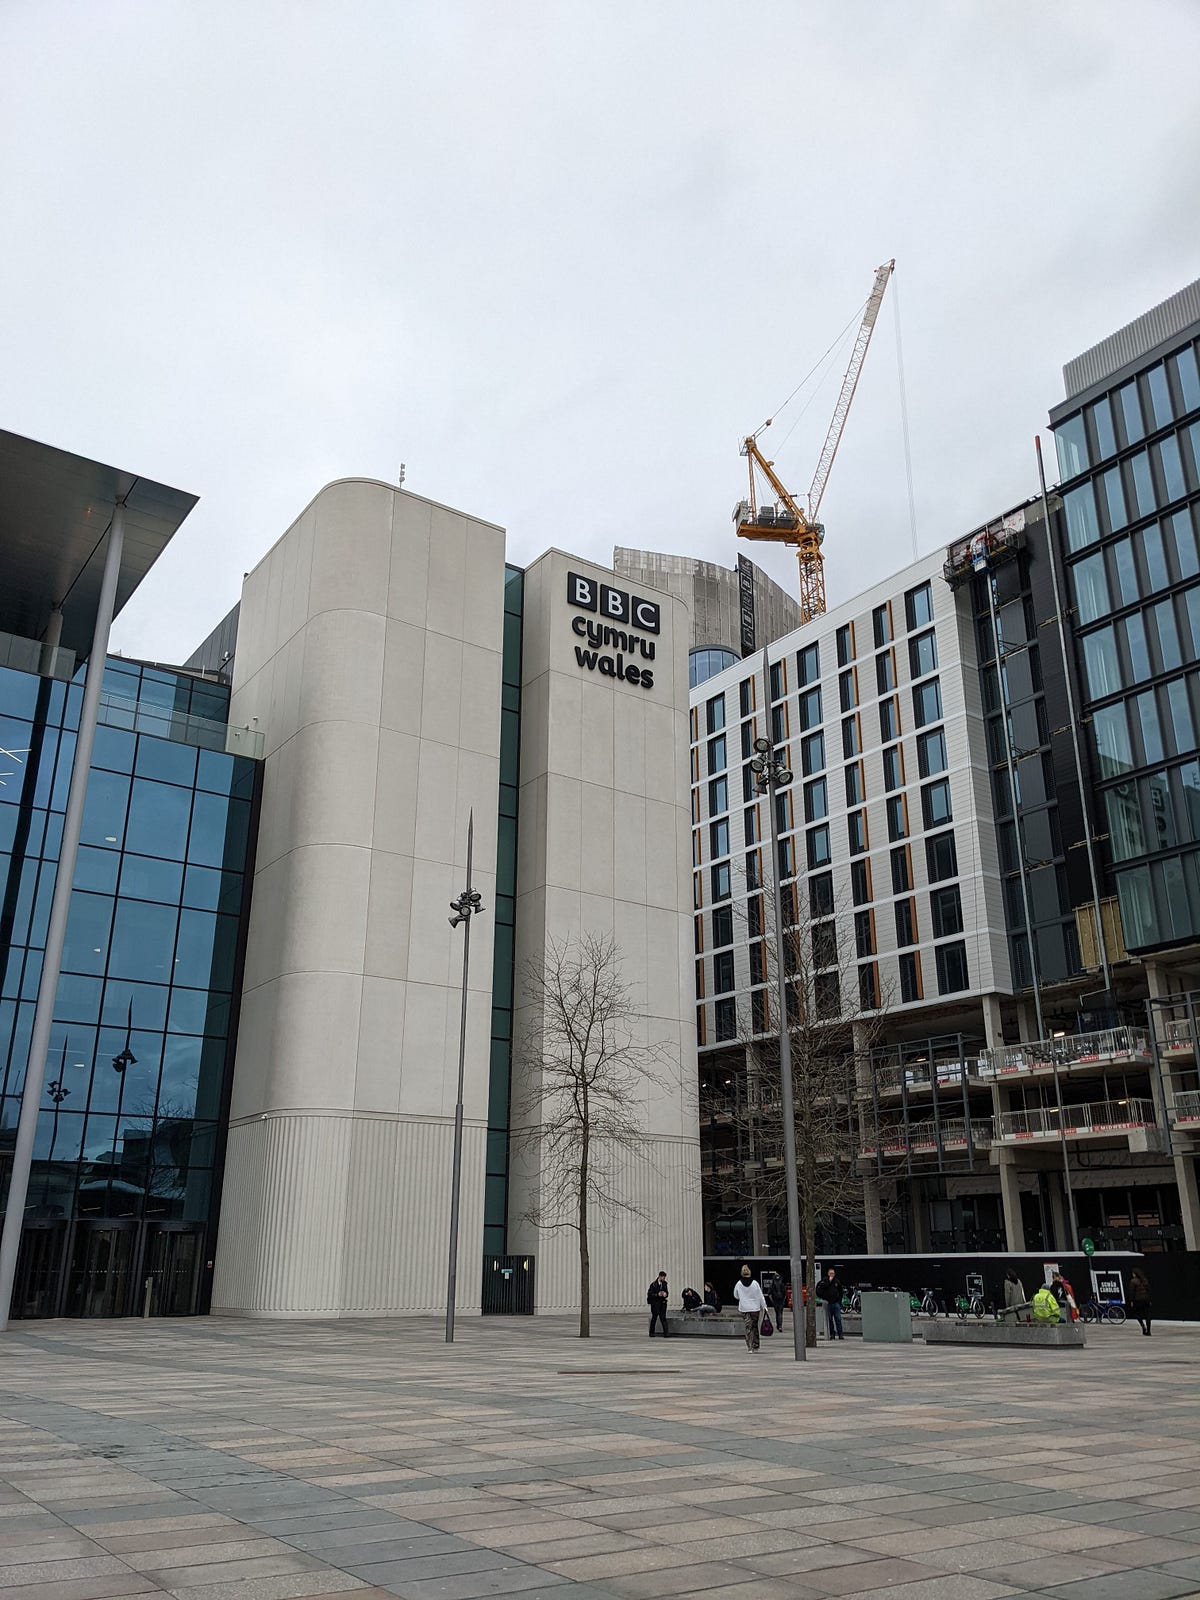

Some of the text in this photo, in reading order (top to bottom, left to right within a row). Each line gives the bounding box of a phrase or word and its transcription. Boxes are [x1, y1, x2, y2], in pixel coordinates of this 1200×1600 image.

[574, 577, 657, 628] BBC
[571, 615, 656, 661] cymru
[574, 645, 655, 689] wales
